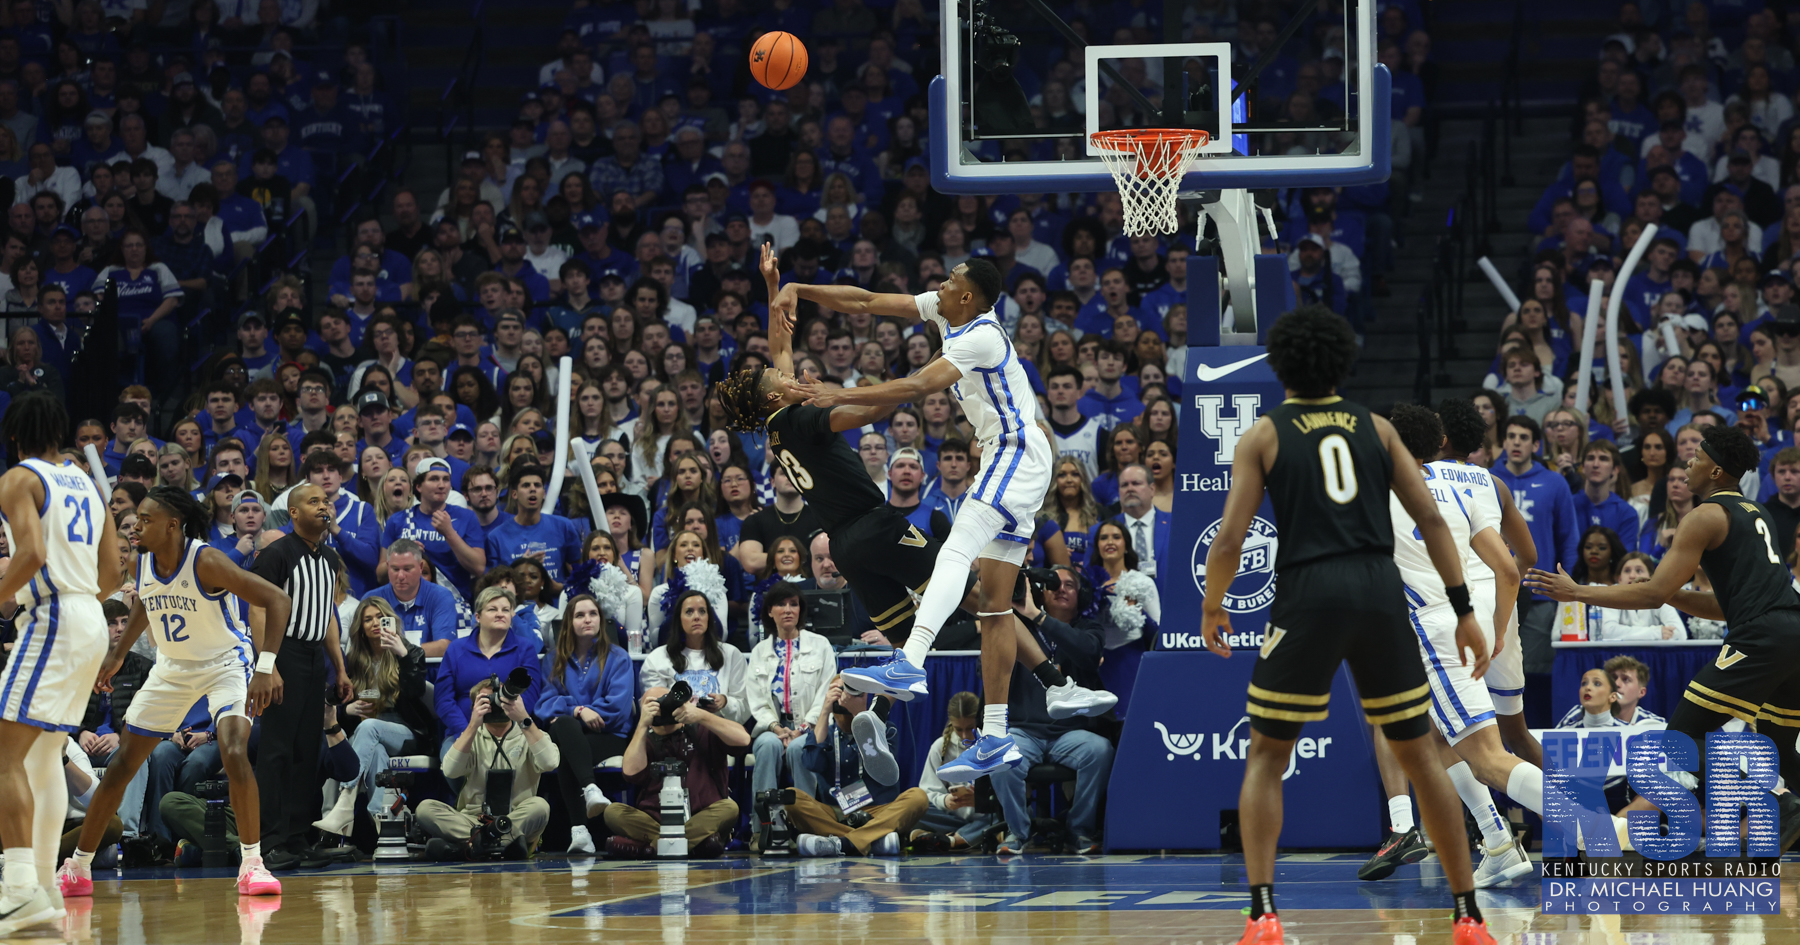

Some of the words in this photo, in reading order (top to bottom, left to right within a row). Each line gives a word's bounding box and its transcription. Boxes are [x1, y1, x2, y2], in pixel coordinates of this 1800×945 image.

[1292, 411, 1358, 434] LAWRENCE
[1318, 433, 1358, 504] 0
[1440, 468, 1489, 487] EDWARDS
[50, 473, 89, 491] WAGNER
[1180, 471, 1234, 492] Heal
[65, 494, 93, 545] 21
[1755, 517, 1780, 564] 2
[1237, 548, 1265, 573] FB
[142, 596, 197, 612] KENTUCKY
[160, 613, 190, 642] 12
